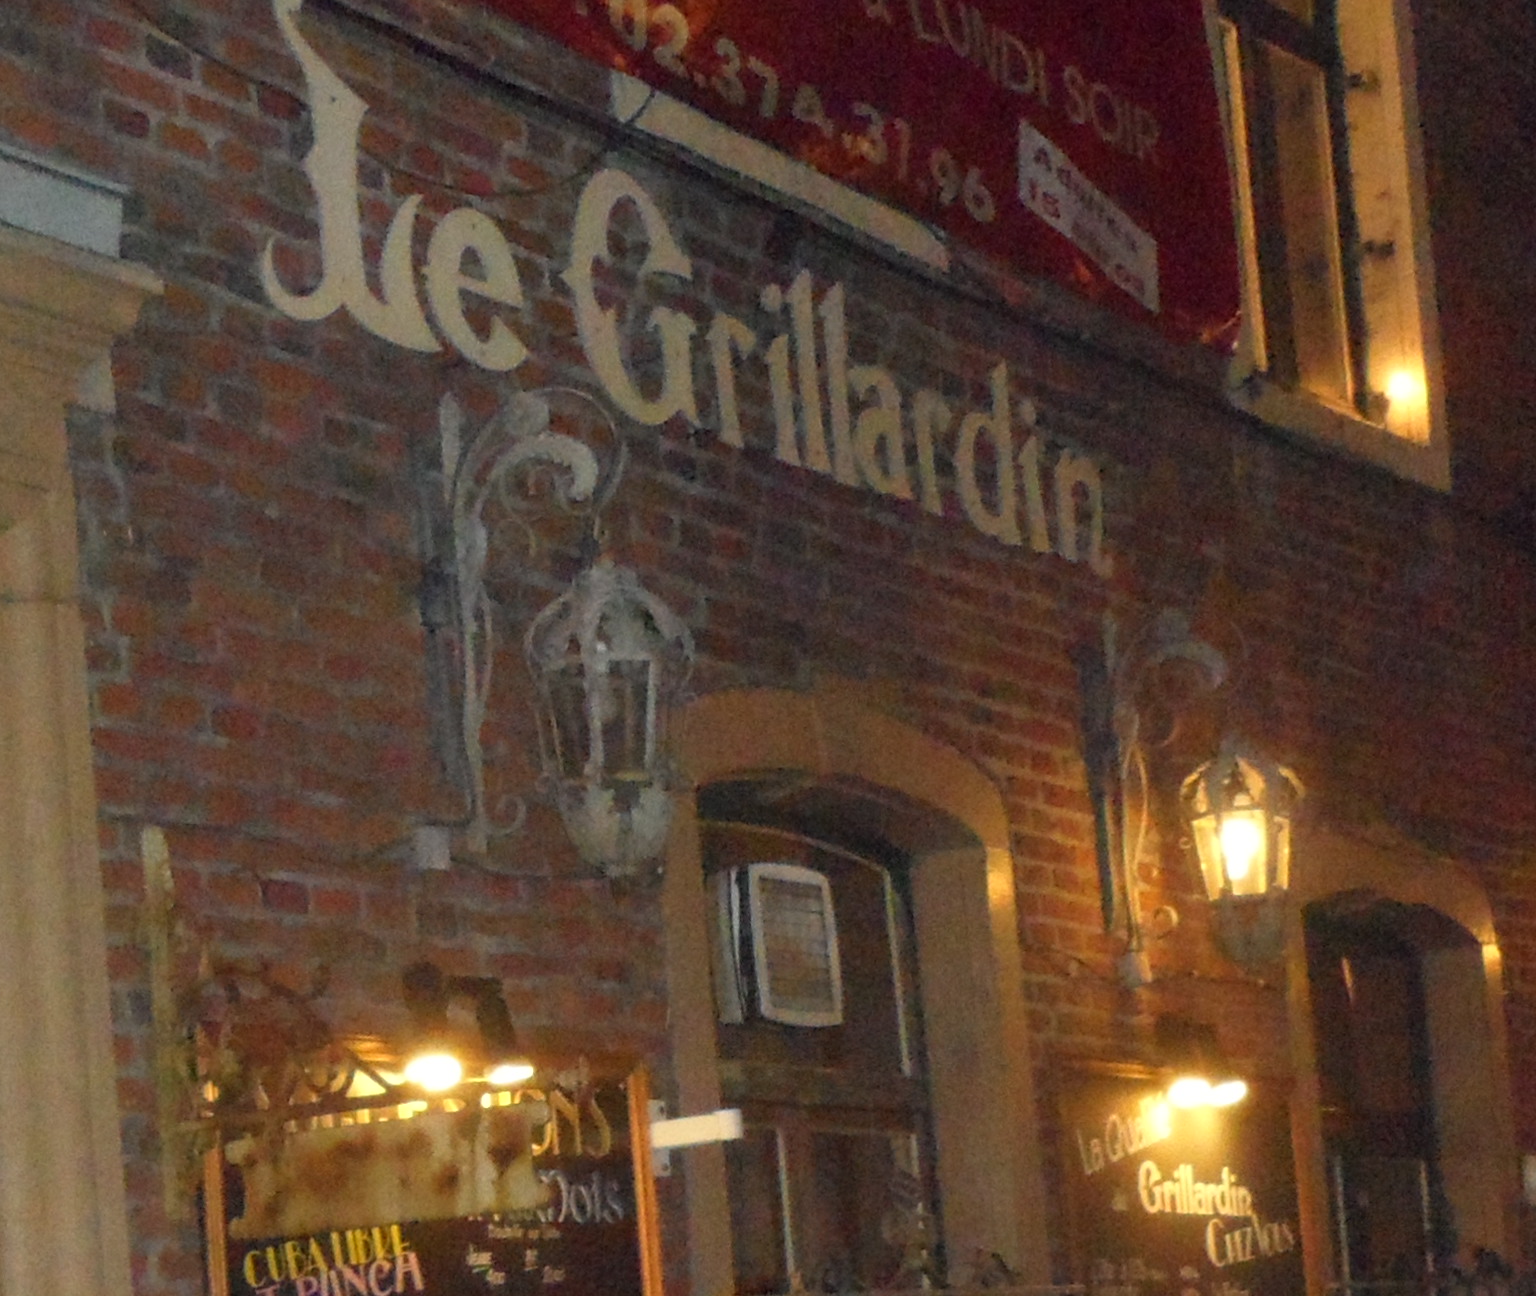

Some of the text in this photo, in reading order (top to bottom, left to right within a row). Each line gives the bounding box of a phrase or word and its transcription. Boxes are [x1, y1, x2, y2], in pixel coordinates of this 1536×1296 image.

[1062, 64, 1162, 168] SOIR
[263, 0, 1114, 577] Le Grillardin
[1137, 1159, 1254, 1217] Grillardin
[242, 1236, 331, 1289] CUBA
